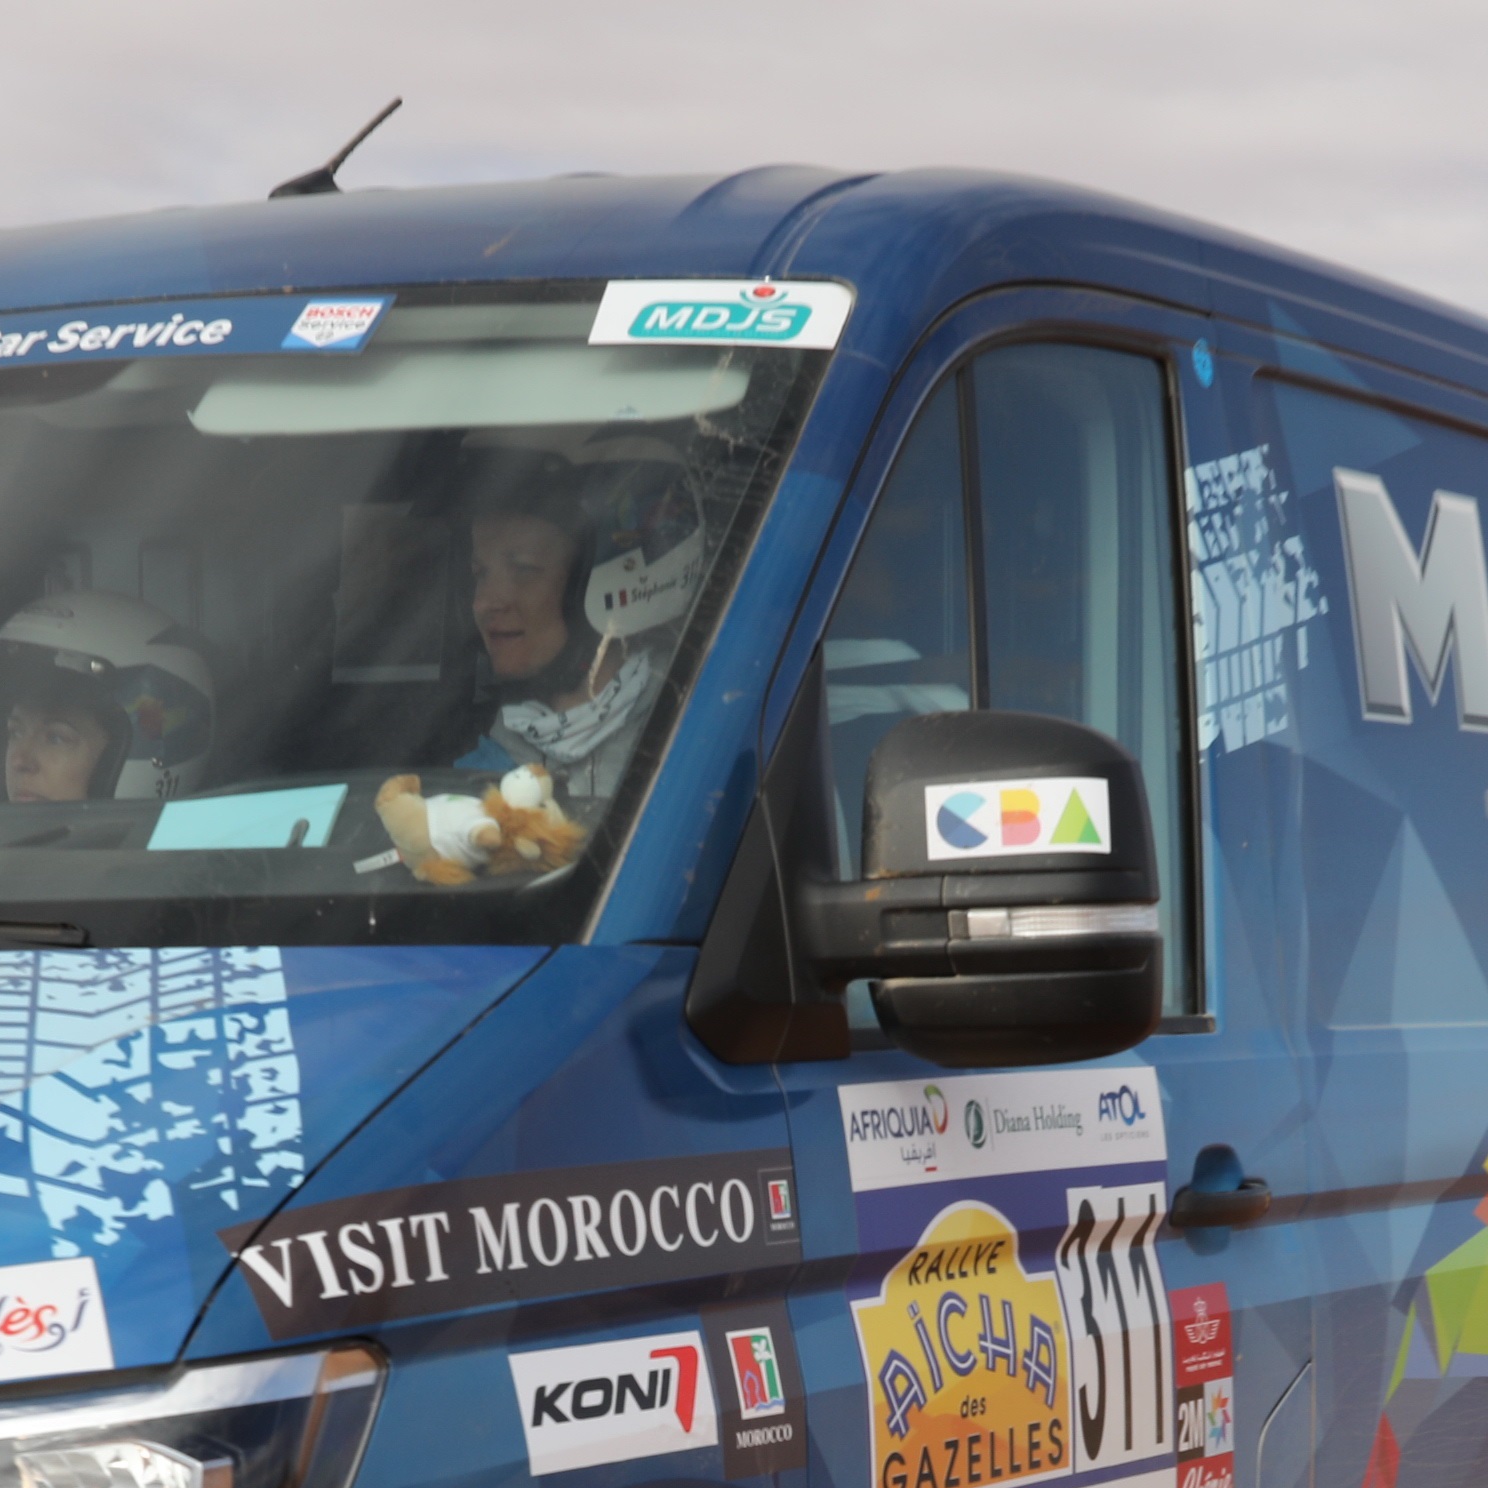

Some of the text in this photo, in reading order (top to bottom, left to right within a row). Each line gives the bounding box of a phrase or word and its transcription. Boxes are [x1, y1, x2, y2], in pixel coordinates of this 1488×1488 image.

[48, 313, 233, 354] Service
[643, 304, 797, 333] MDJS
[936, 786, 1102, 850] CBA
[849, 1106, 933, 1142] AFRIQUIA
[993, 1103, 1084, 1136] Diana Holding
[1098, 1085, 1146, 1126] ATOL
[230, 1179, 755, 1307] VISIT MOROCCO
[909, 1241, 1006, 1286] RALLYE
[1062, 1192, 1164, 1461] 311
[531, 1367, 671, 1428] KONI
[960, 1396, 986, 1418] des
[735, 1423, 793, 1449] MOROCCO
[1178, 1398, 1204, 1452] 2M
